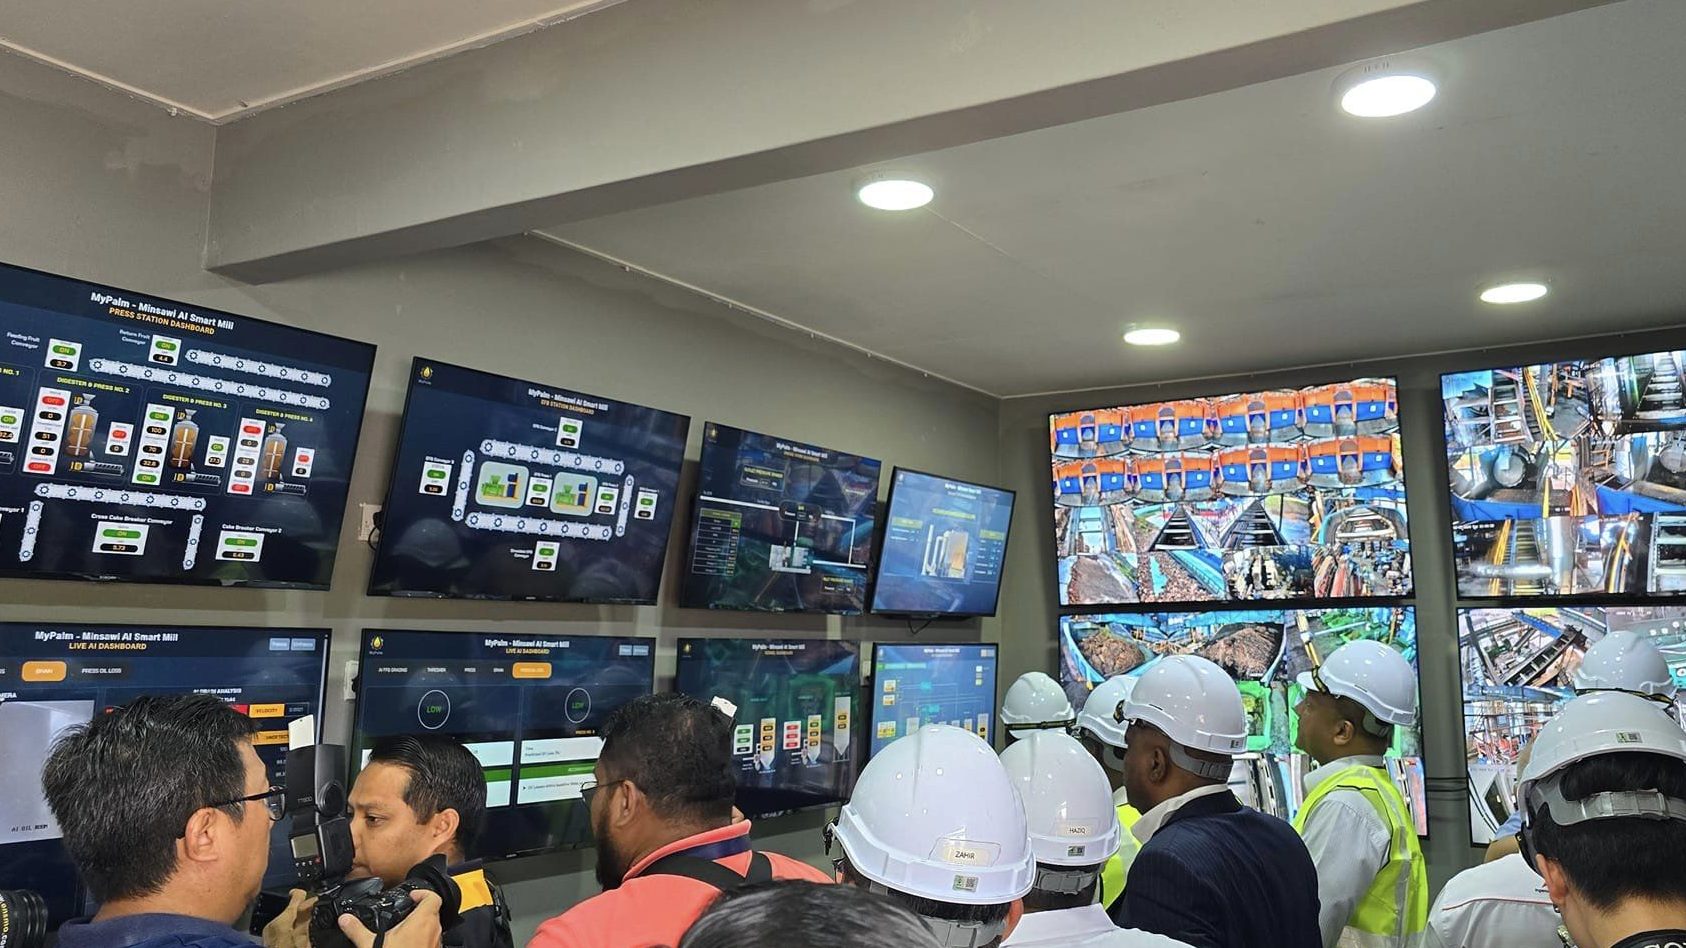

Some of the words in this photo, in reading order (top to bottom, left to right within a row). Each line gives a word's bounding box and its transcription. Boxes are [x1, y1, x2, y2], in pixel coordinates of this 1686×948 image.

[91, 292, 130, 308] MyPalm
[138, 302, 177, 318] Minsawi
[177, 311, 188, 321] AI
[190, 314, 217, 327] Smart
[217, 319, 234, 330] Mill
[109, 307, 135, 319] PRESS
[136, 312, 169, 326] STATION
[170, 320, 215, 335] DASHBOARD
[7, 331, 28, 342] Feeding
[27, 335, 41, 343] Fruit
[57, 377, 87, 387] DIGESTER
[93, 383, 114, 391] PRESS
[528, 388, 550, 398] MyPalm
[162, 394, 190, 403] DIGESTER
[195, 399, 213, 407] PRESS
[4, 415, 14, 423] ON
[91, 513, 109, 521] Cross
[34, 631, 74, 642] MyPalm
[82, 631, 121, 641] Minsawi
[121, 632, 133, 641] AI
[133, 633, 161, 641] Smart
[162, 633, 179, 642] Mill
[69, 642, 87, 650] LIVE
[88, 642, 98, 650] AI
[98, 642, 147, 650] DASHBOARD
[485, 638, 508, 648] MyPalm
[426, 706, 443, 714] LOW
[571, 701, 585, 709] LOW
[954, 850, 975, 860] ZAMIR
